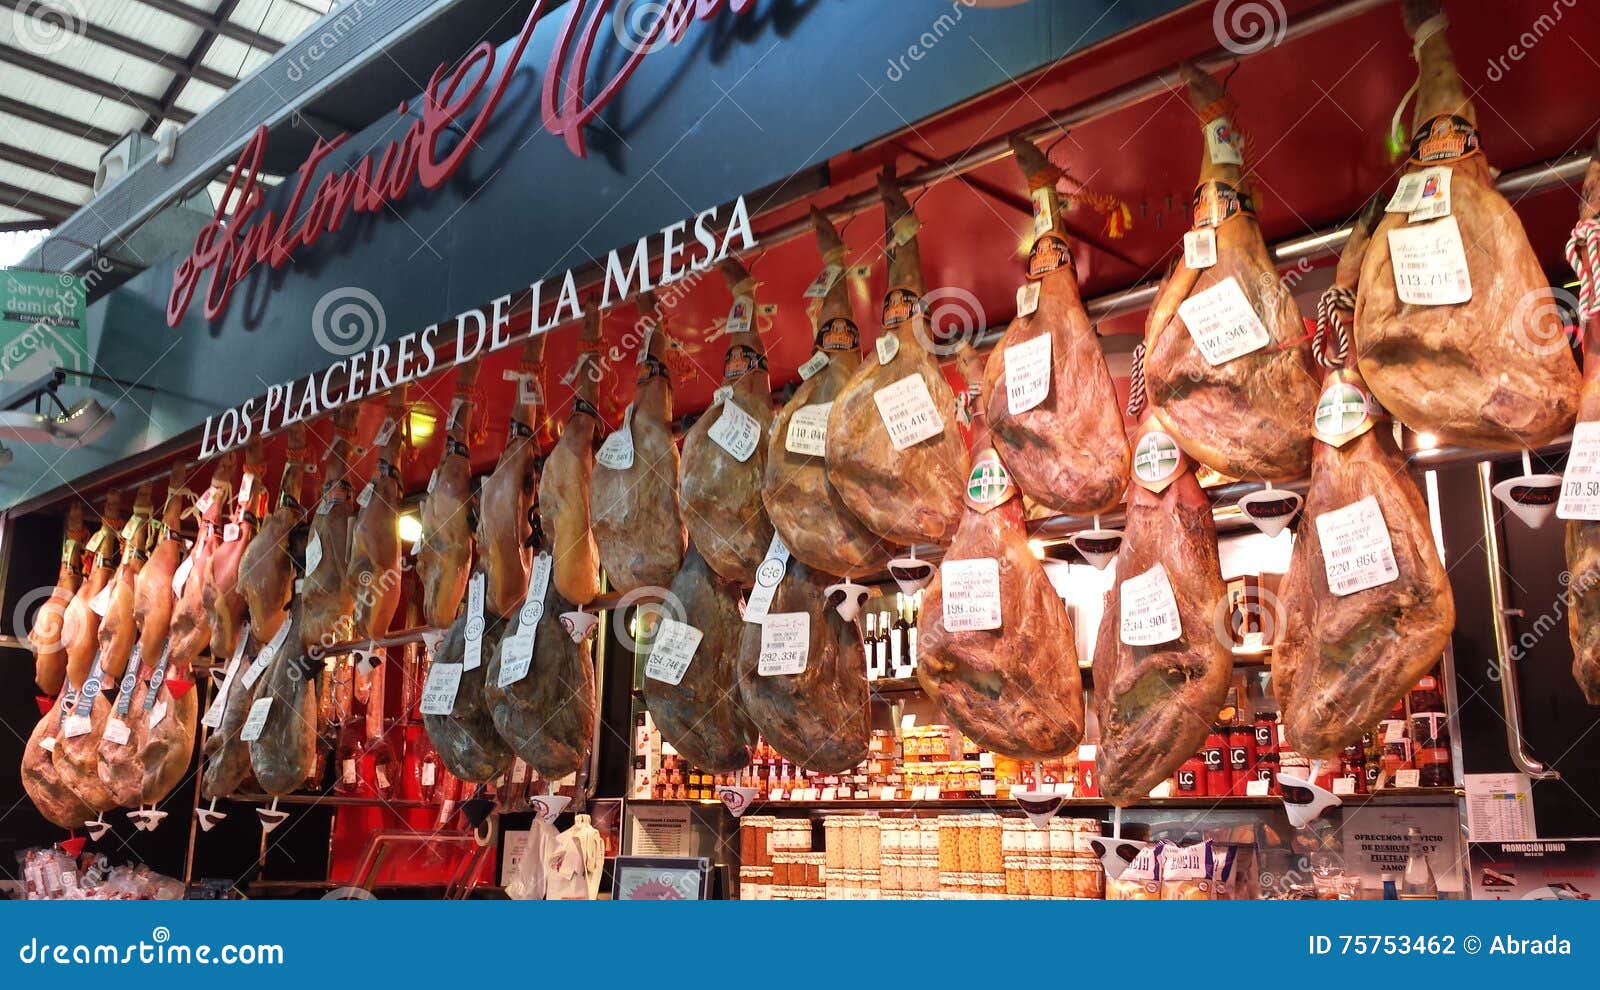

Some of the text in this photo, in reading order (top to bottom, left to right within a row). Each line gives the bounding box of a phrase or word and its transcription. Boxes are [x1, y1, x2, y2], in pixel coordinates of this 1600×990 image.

[198, 194, 760, 460] LOS PLACERES DE LA MESA
[761, 651, 797, 662] 292.33€
[1256, 728, 1269, 740] LC
[1205, 750, 1221, 764] LC
[1231, 750, 1246, 764] LC
[1179, 772, 1193, 785] LC
